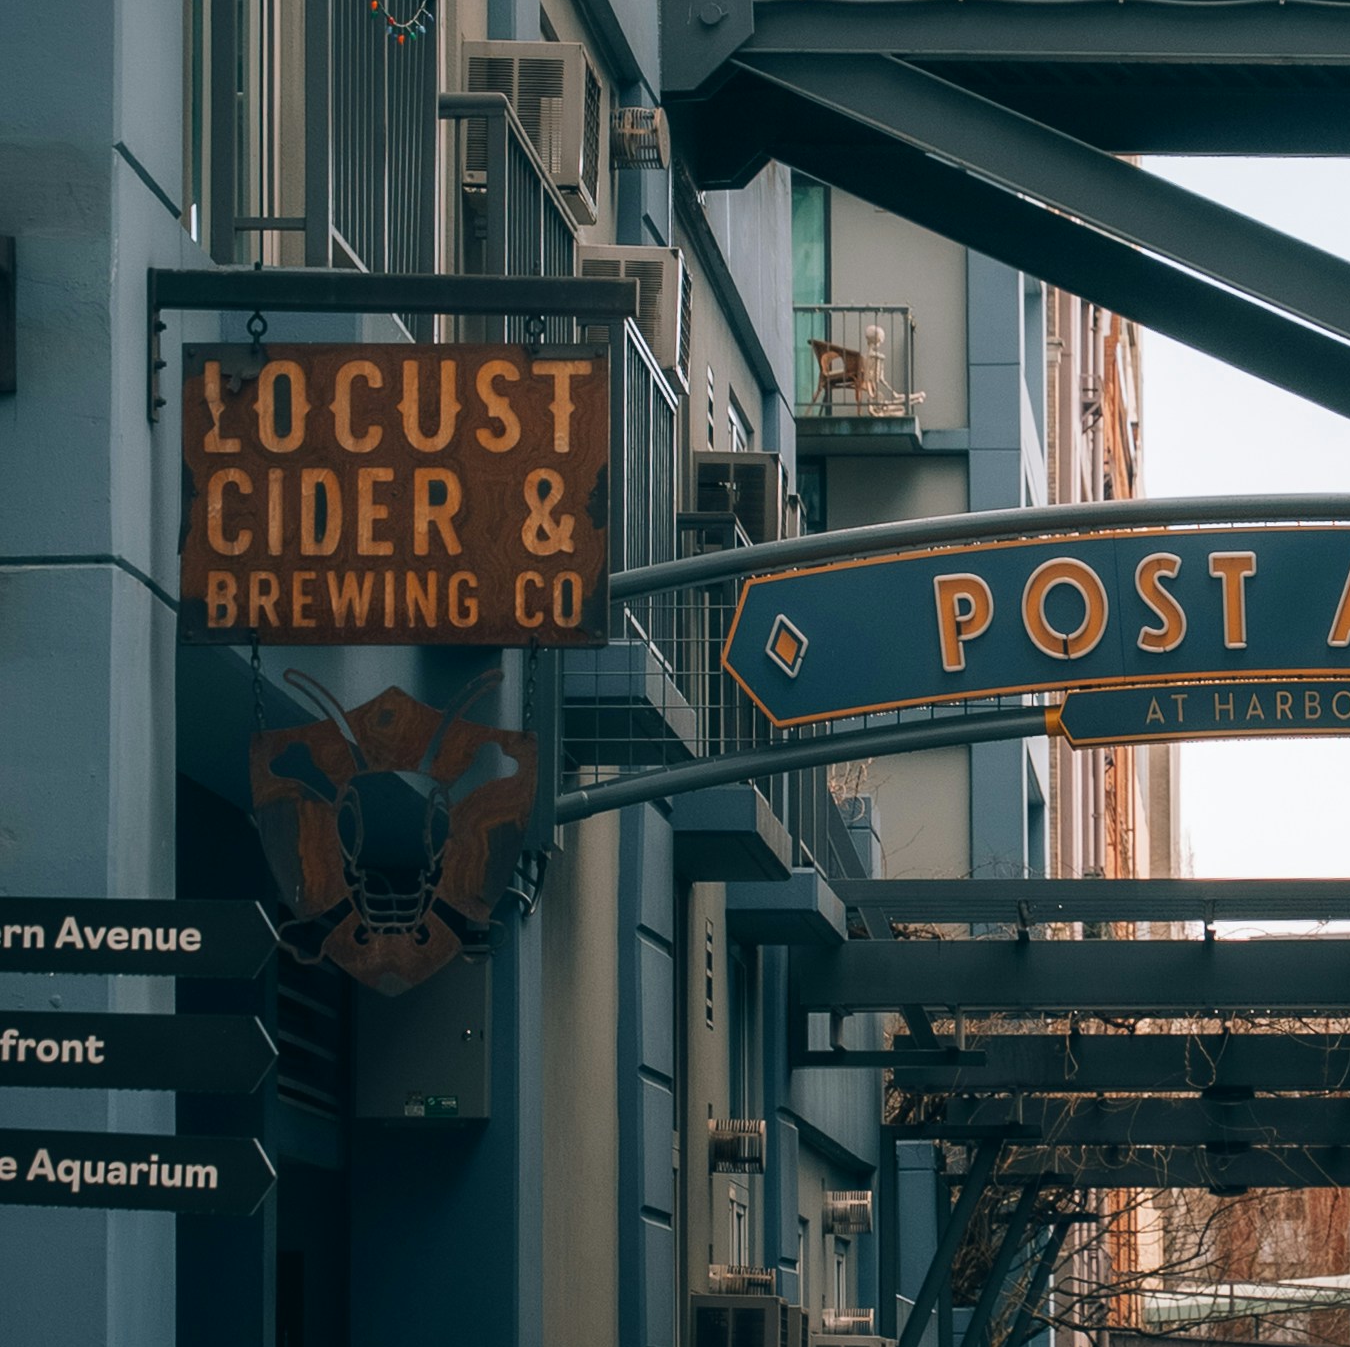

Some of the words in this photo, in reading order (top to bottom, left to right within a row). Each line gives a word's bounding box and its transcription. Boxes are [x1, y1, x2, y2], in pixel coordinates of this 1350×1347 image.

[204, 359, 593, 454] LOCUST
[207, 466, 463, 557] CIDER
[521, 467, 576, 557] &
[206, 569, 480, 629] BREWING
[514, 569, 583, 629] CO
[932, 550, 1257, 672] POST
[1146, 694, 1189, 725] AT
[0, 923, 45, 949] rn
[54, 916, 202, 951] Avenue
[0, 1028, 105, 1064] front
[26, 1148, 219, 1193] Aquarium
